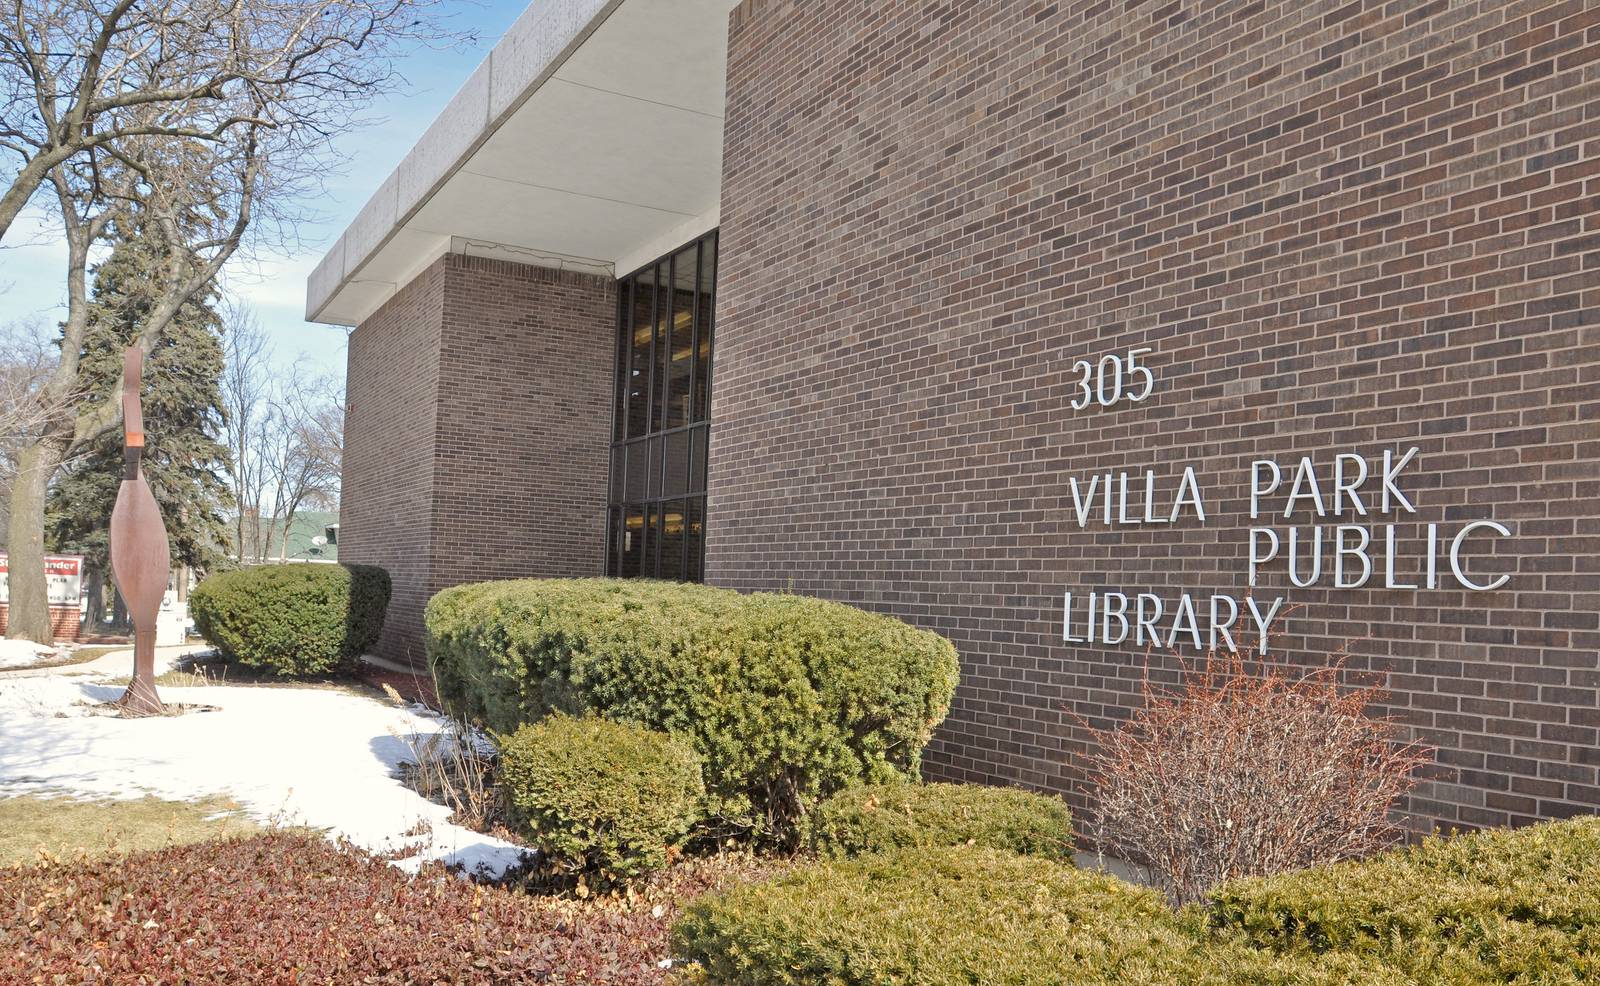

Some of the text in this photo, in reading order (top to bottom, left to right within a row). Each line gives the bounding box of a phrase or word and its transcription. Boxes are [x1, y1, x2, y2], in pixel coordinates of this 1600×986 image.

[1070, 347, 1154, 410] 305
[1069, 446, 1420, 527] VILLA PARK
[1249, 520, 1512, 591] PUBLIC
[1062, 591, 1284, 656] LIBRARY
